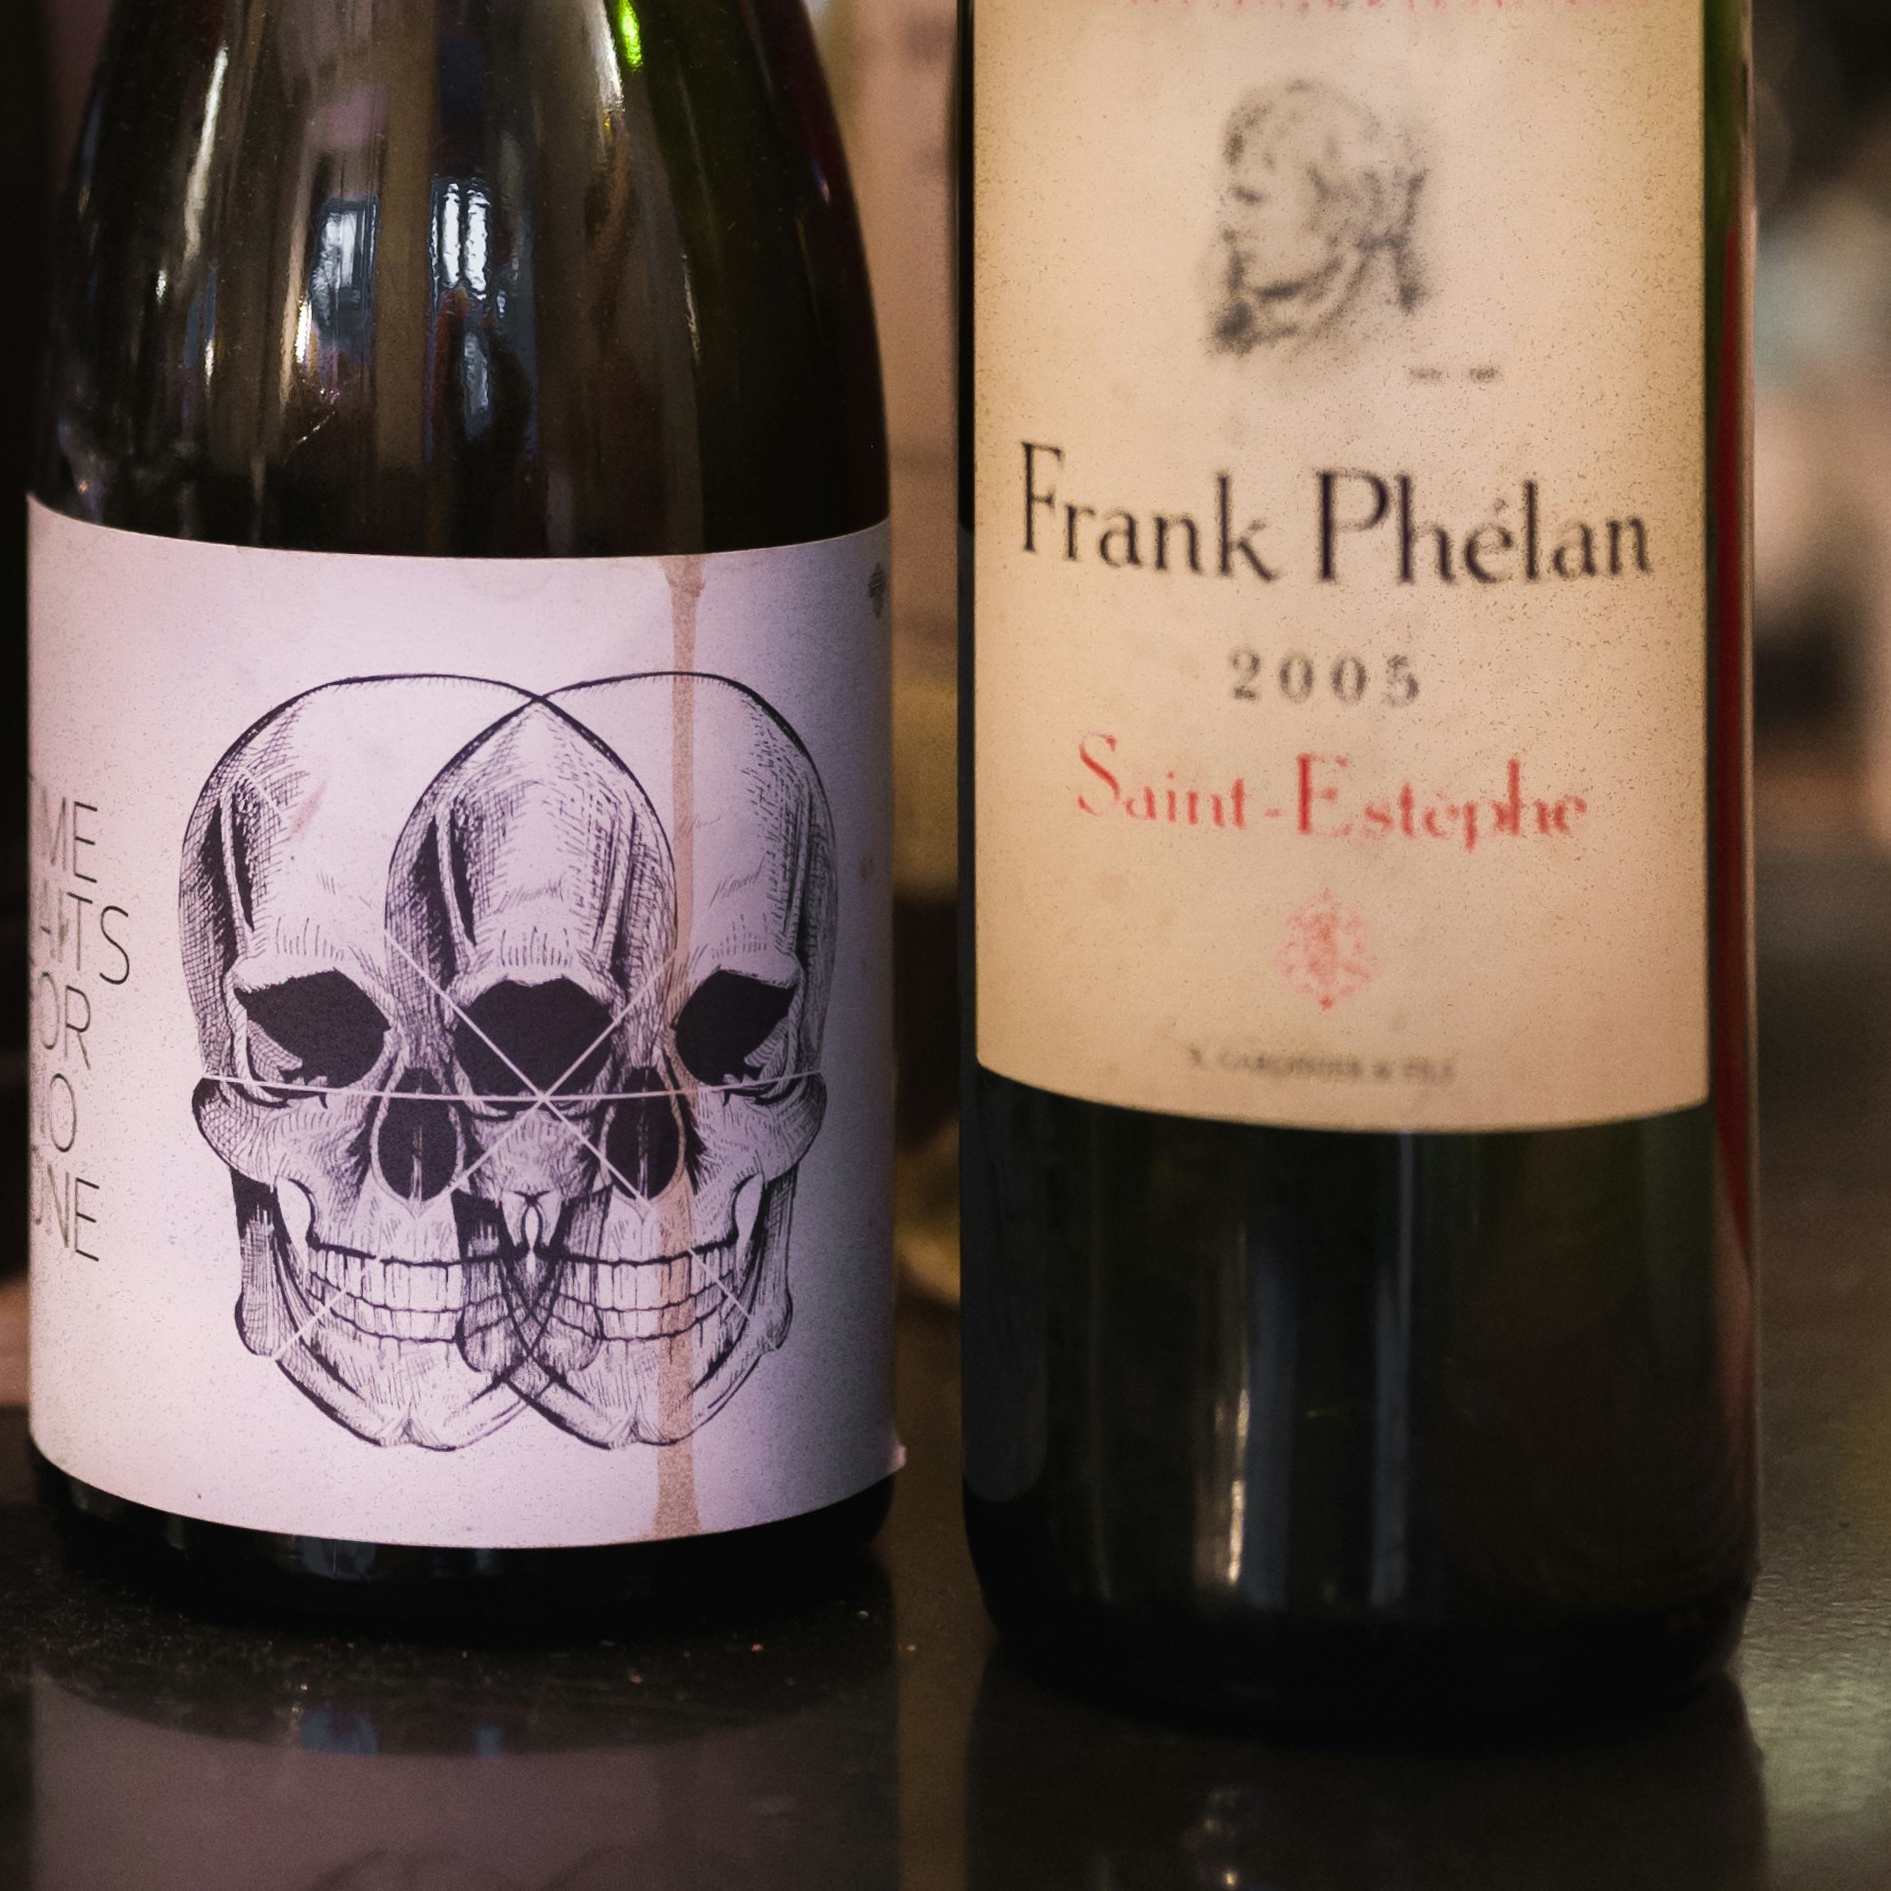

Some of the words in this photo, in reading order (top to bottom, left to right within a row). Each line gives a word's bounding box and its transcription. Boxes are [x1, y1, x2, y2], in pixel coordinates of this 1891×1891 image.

[1021, 441, 1282, 584] Frank
[1315, 468, 1653, 586] Phélan
[1228, 647, 1420, 706] 2005
